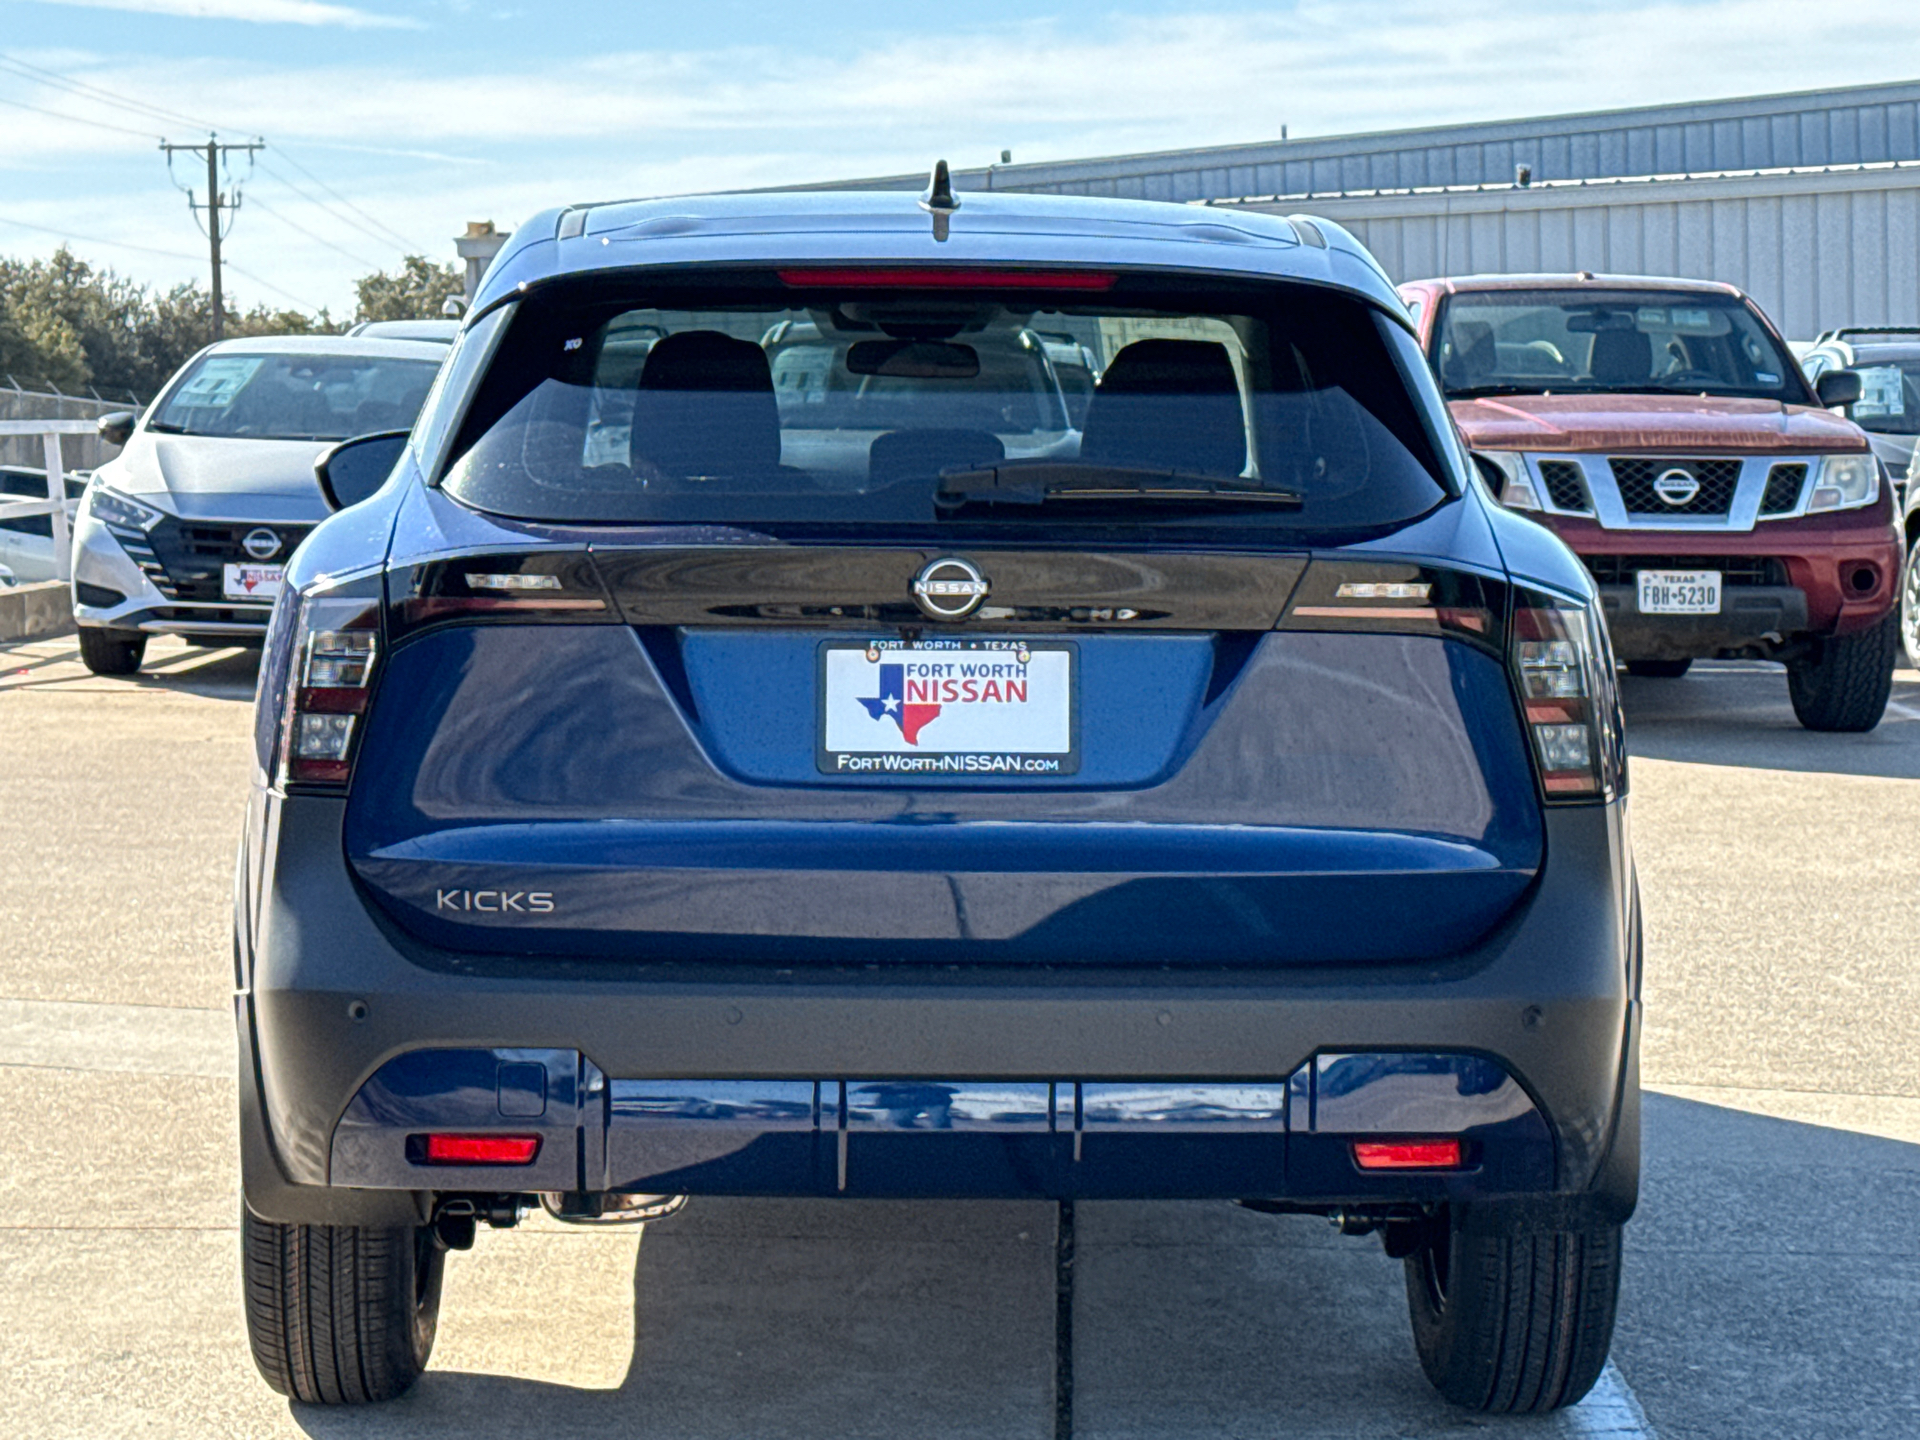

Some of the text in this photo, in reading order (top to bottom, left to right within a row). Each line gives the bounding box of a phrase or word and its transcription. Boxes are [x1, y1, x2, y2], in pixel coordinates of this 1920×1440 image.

[1663, 575, 1696, 584] TEXAS
[914, 582, 987, 594] NISSAN
[870, 640, 1027, 650] FORT WORTH TEXAS
[906, 663, 1027, 678] FORT WORTH
[906, 679, 1028, 703] NISSAN
[436, 889, 555, 912] KICKS
